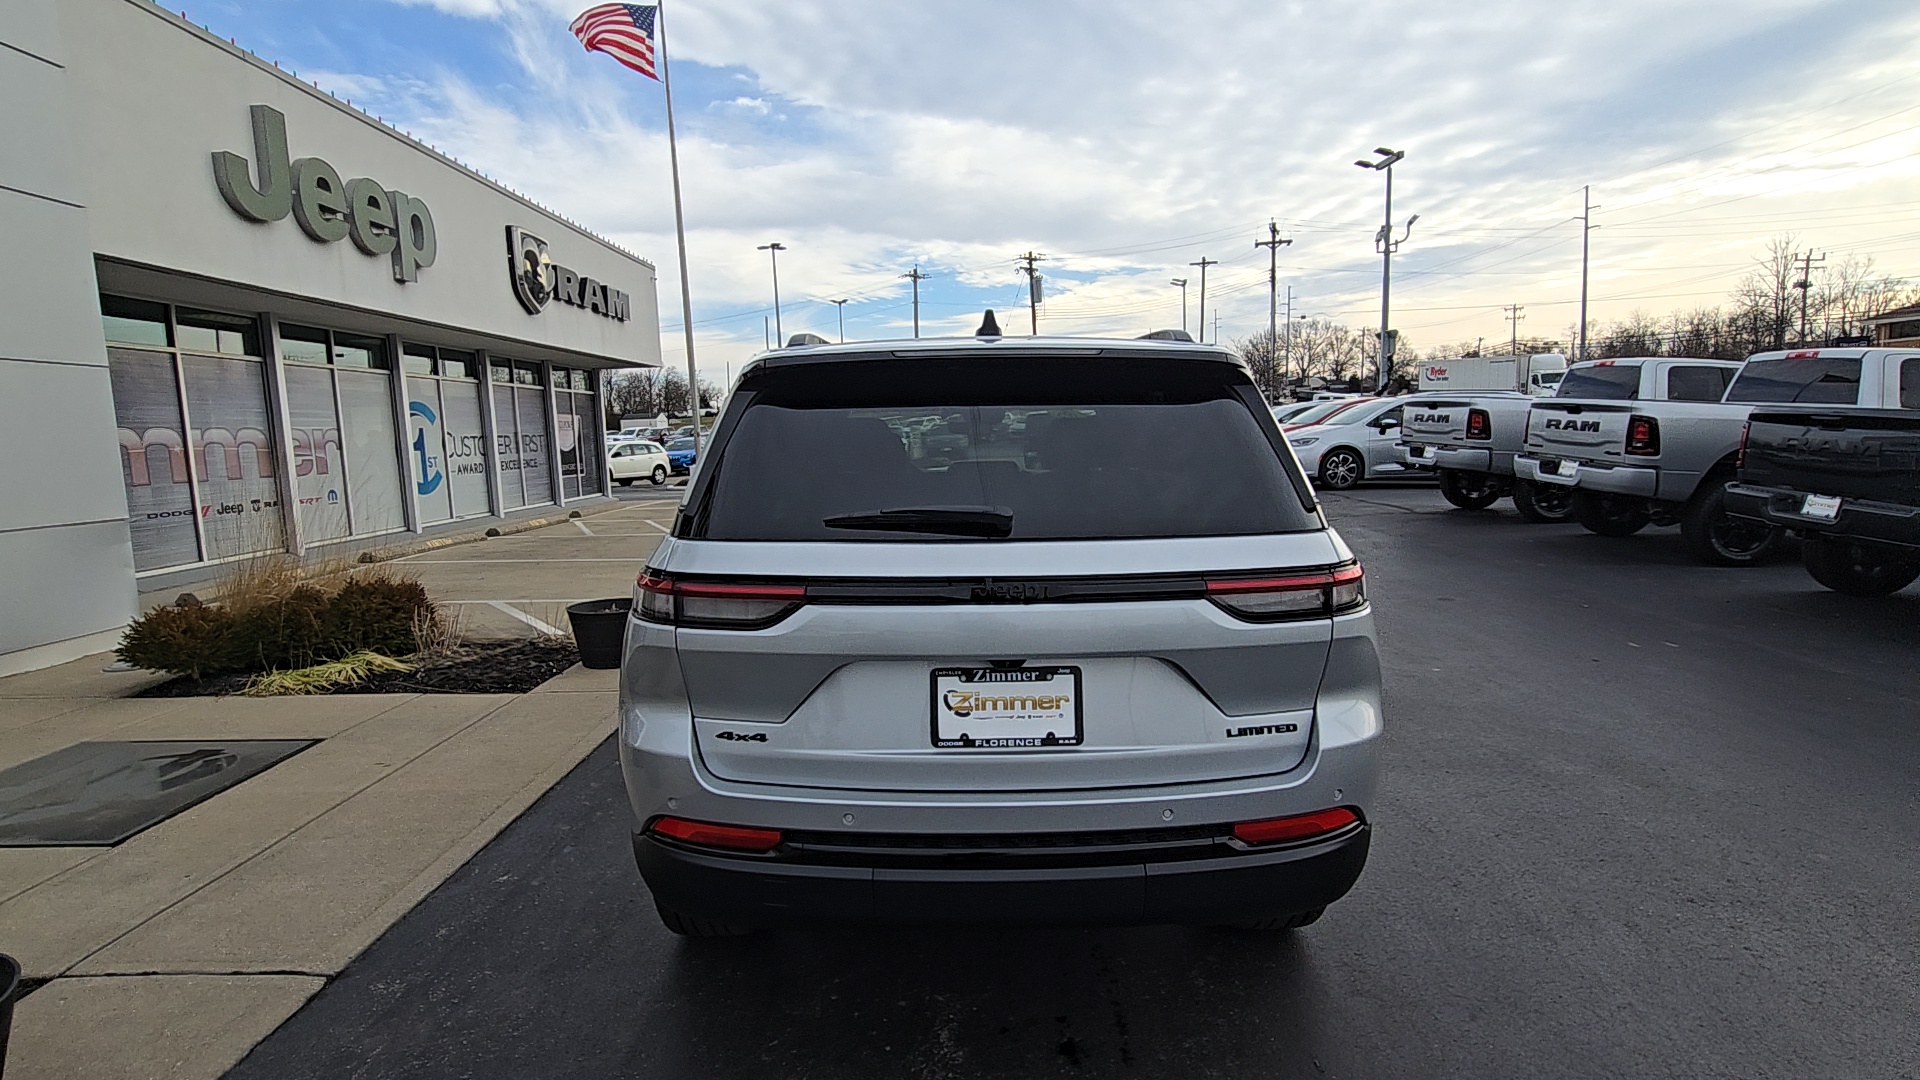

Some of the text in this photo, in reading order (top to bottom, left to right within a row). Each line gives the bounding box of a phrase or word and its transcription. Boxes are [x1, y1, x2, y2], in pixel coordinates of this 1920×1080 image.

[211, 104, 437, 284] Jeep
[551, 264, 631, 322] RAM
[1430, 366, 1447, 377] Ryder
[1413, 413, 1450, 424] RAM
[1545, 418, 1601, 433] RAM
[446, 431, 512, 458] CUSTOER
[457, 458, 538, 475] AWARD EXCEENCE
[146, 509, 194, 519] DODG
[216, 502, 244, 515] Jeep
[299, 497, 322, 505] SRT
[970, 578, 1049, 604] Jeep
[973, 669, 1039, 682] Zimmer
[951, 691, 1070, 712] Zimmer
[715, 731, 769, 743] 4x4
[1226, 723, 1298, 738] LIMITED
[975, 739, 1042, 747] FLORENCE
